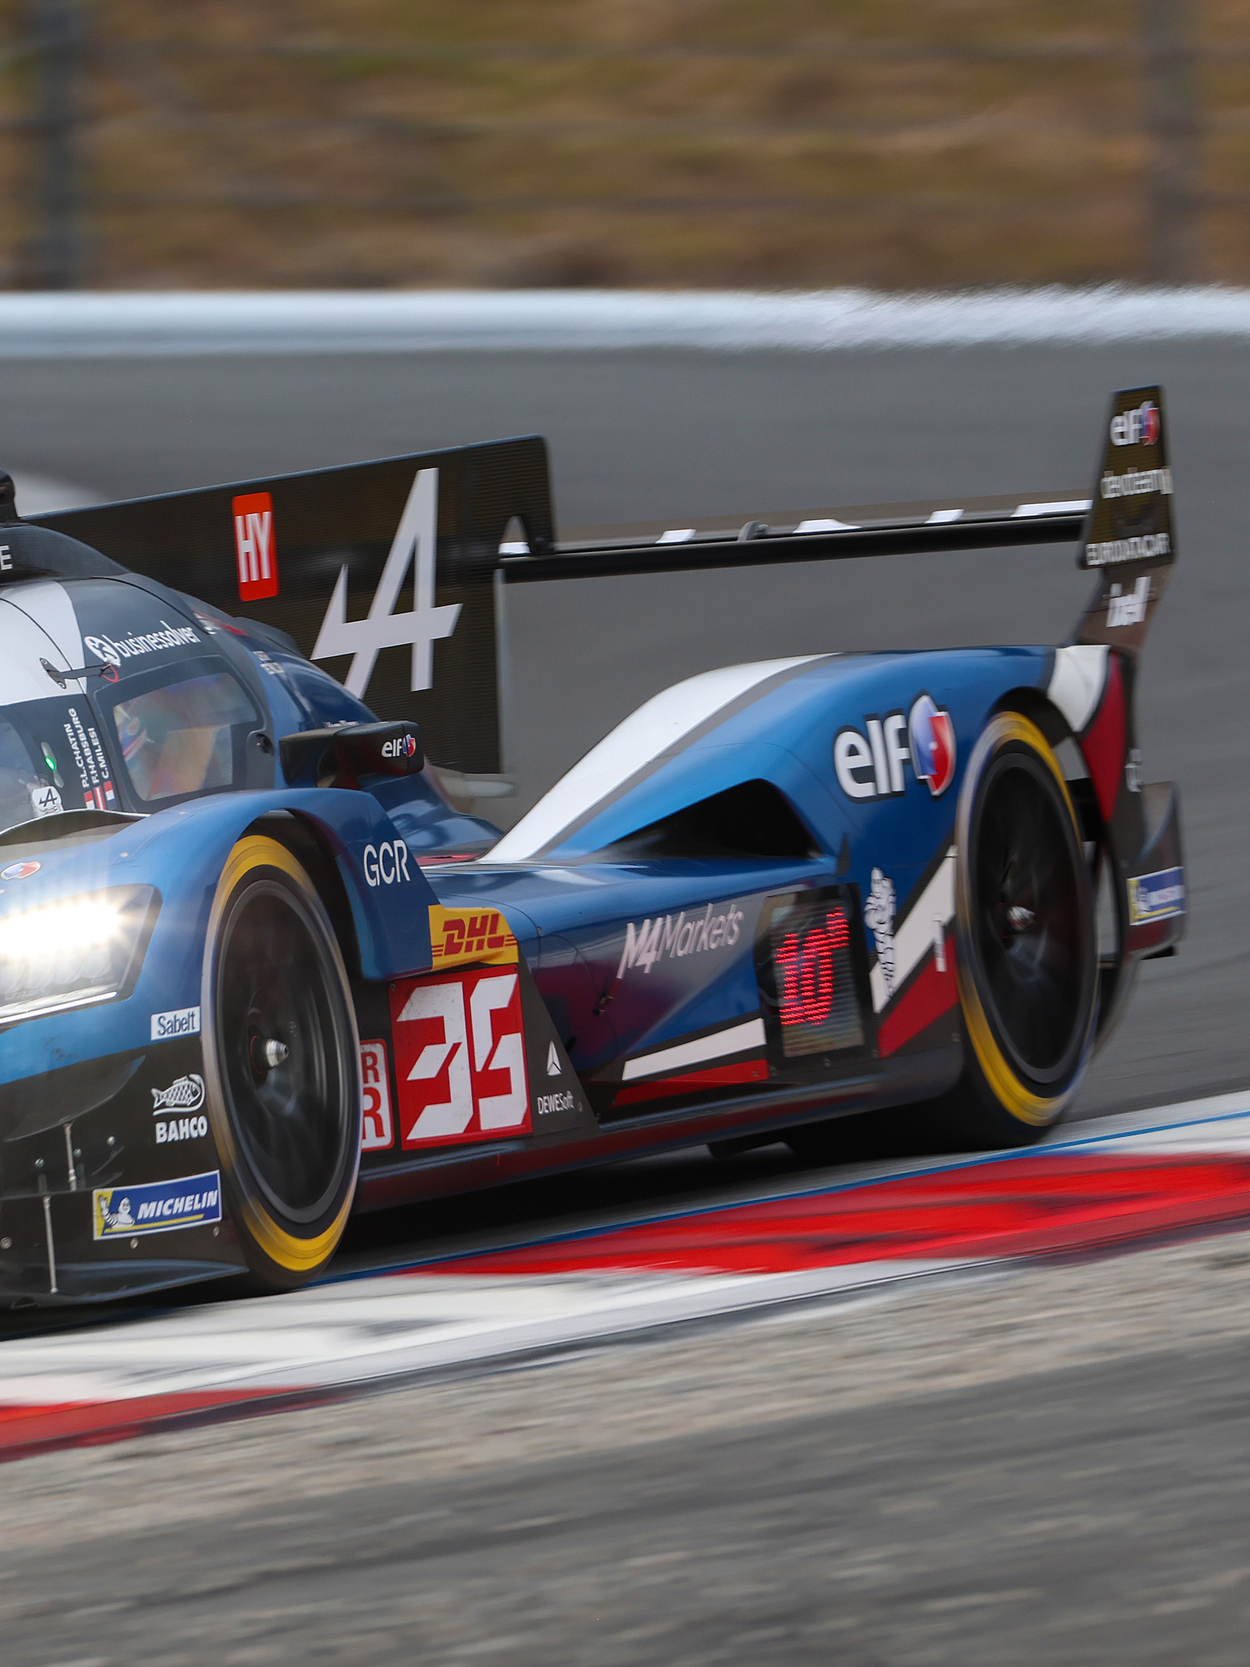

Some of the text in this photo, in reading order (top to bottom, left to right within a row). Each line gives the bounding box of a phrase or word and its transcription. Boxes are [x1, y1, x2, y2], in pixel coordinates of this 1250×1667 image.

[235, 511, 272, 583] HY
[101, 619, 202, 658] businessolver
[381, 738, 403, 757] elf
[834, 712, 910, 798] elf
[363, 839, 410, 887] GCR
[442, 913, 507, 956] DHL
[616, 902, 745, 979] M4Markets
[157, 1010, 197, 1037] Sabelt
[396, 973, 528, 1141] 35
[155, 1115, 208, 1144] BAHCO
[136, 1189, 219, 1220] MICHELIN
